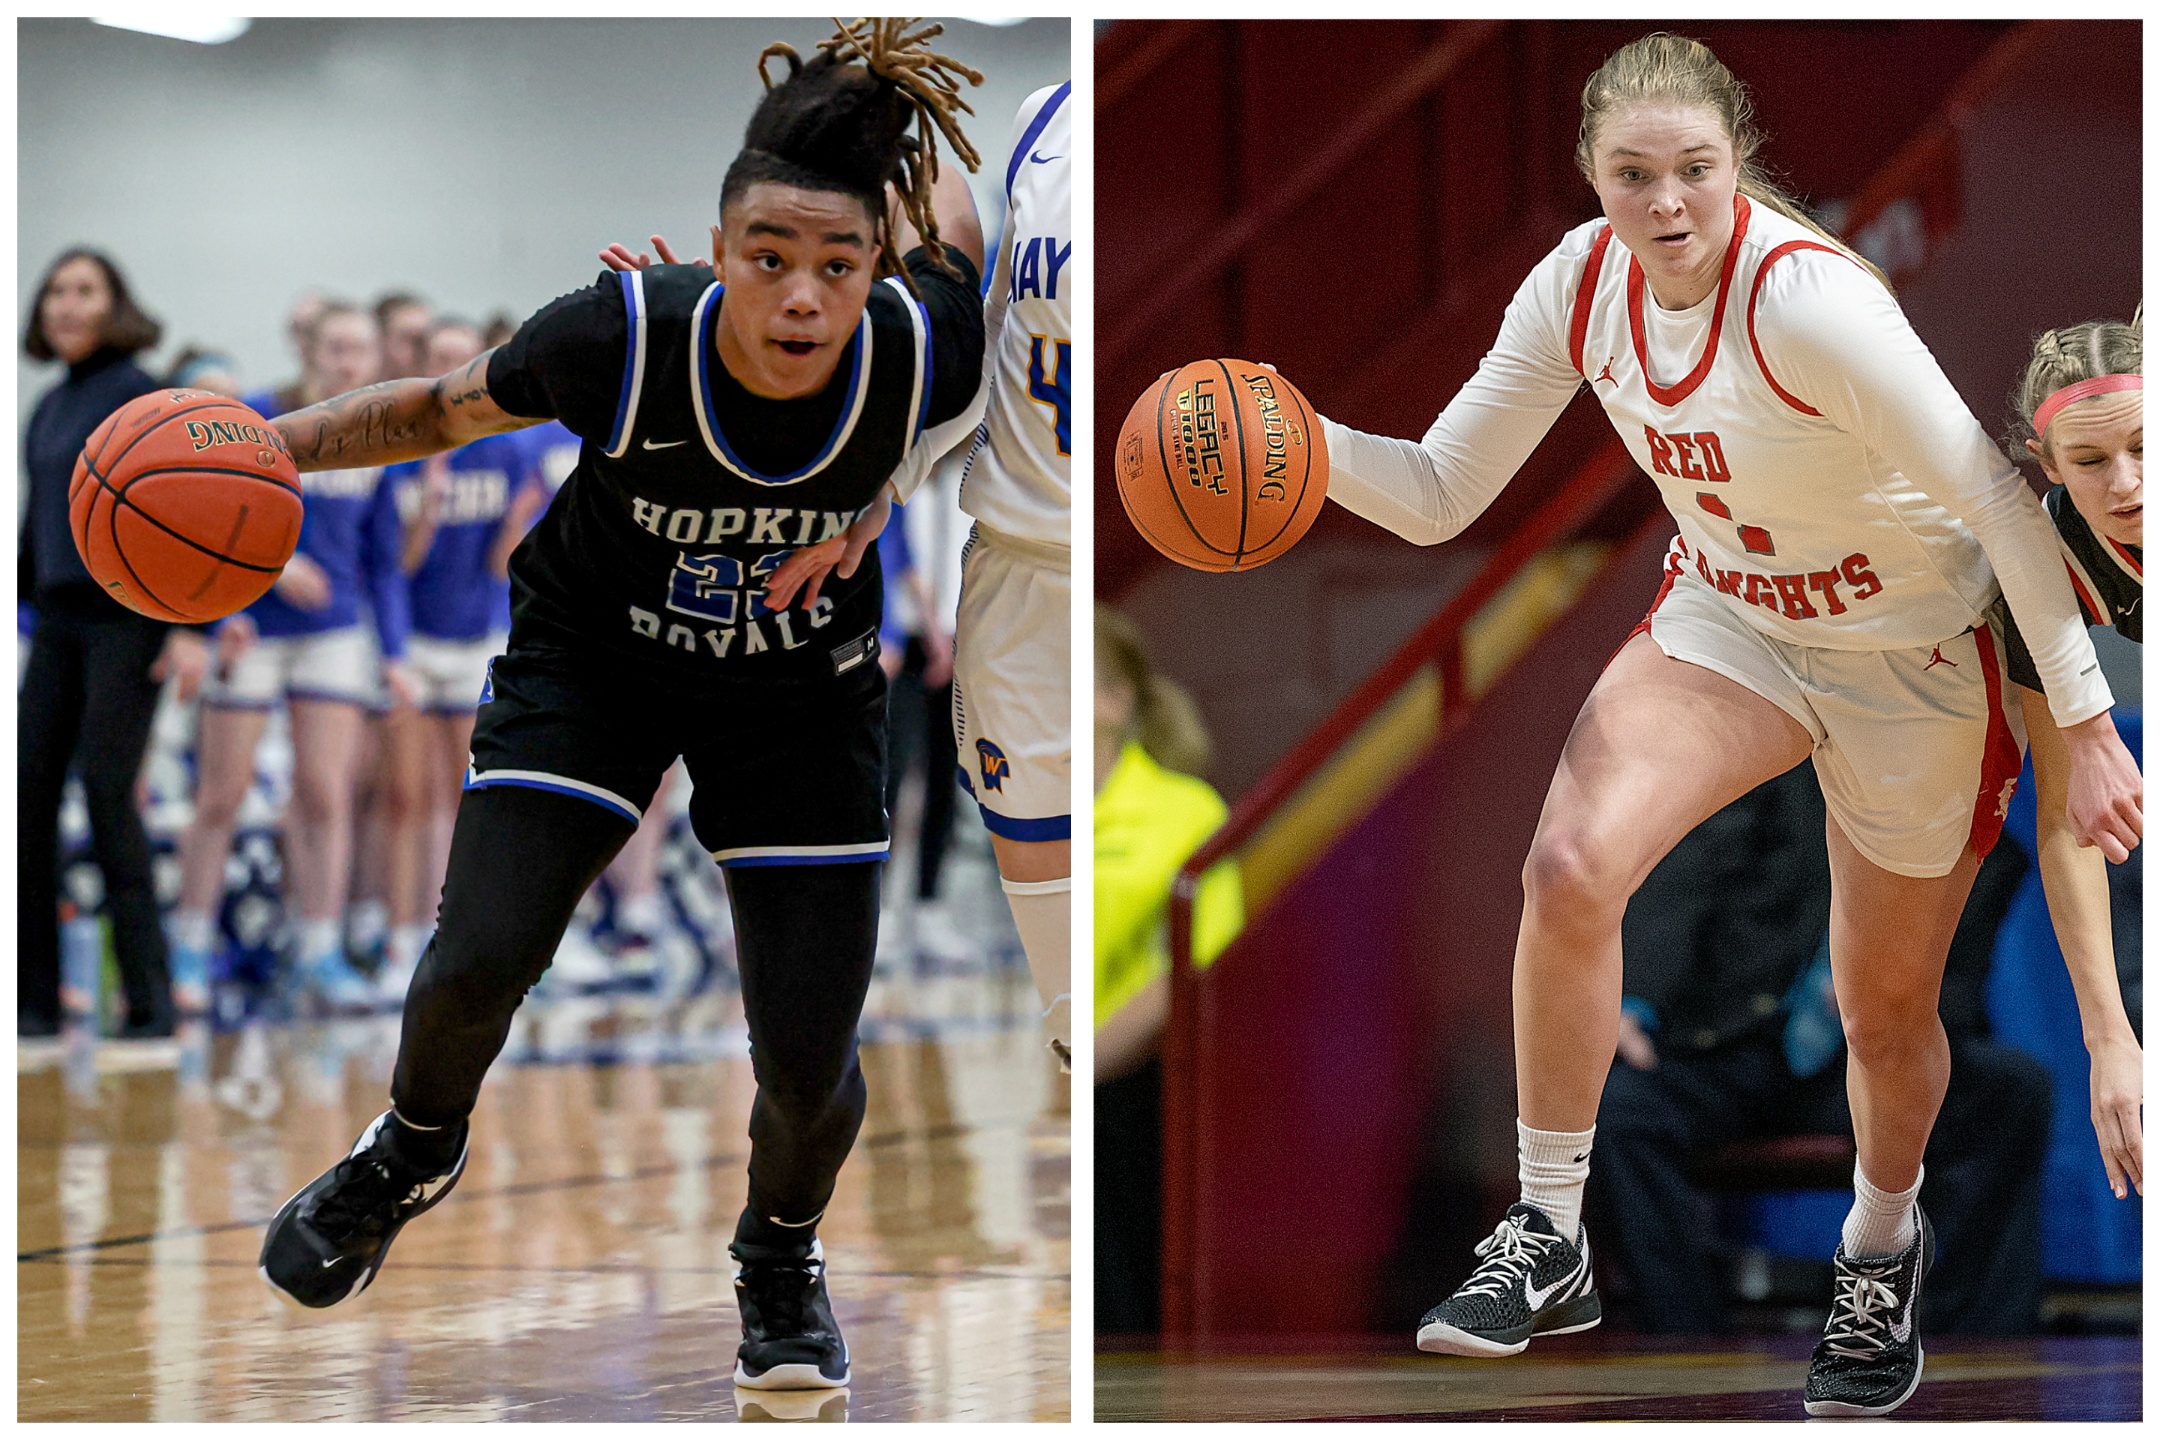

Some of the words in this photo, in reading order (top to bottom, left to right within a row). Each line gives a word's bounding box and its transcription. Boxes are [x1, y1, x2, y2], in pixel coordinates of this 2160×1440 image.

[1008, 237, 1071, 303] AY
[1026, 333, 1071, 456] 4
[184, 419, 296, 466] ALDING
[1180, 412, 1202, 487] 1000
[1194, 379, 1229, 497] LEGACY
[1241, 374, 1287, 502] SPALDING
[1644, 424, 1732, 483] RED
[632, 496, 874, 545] HOPKIN
